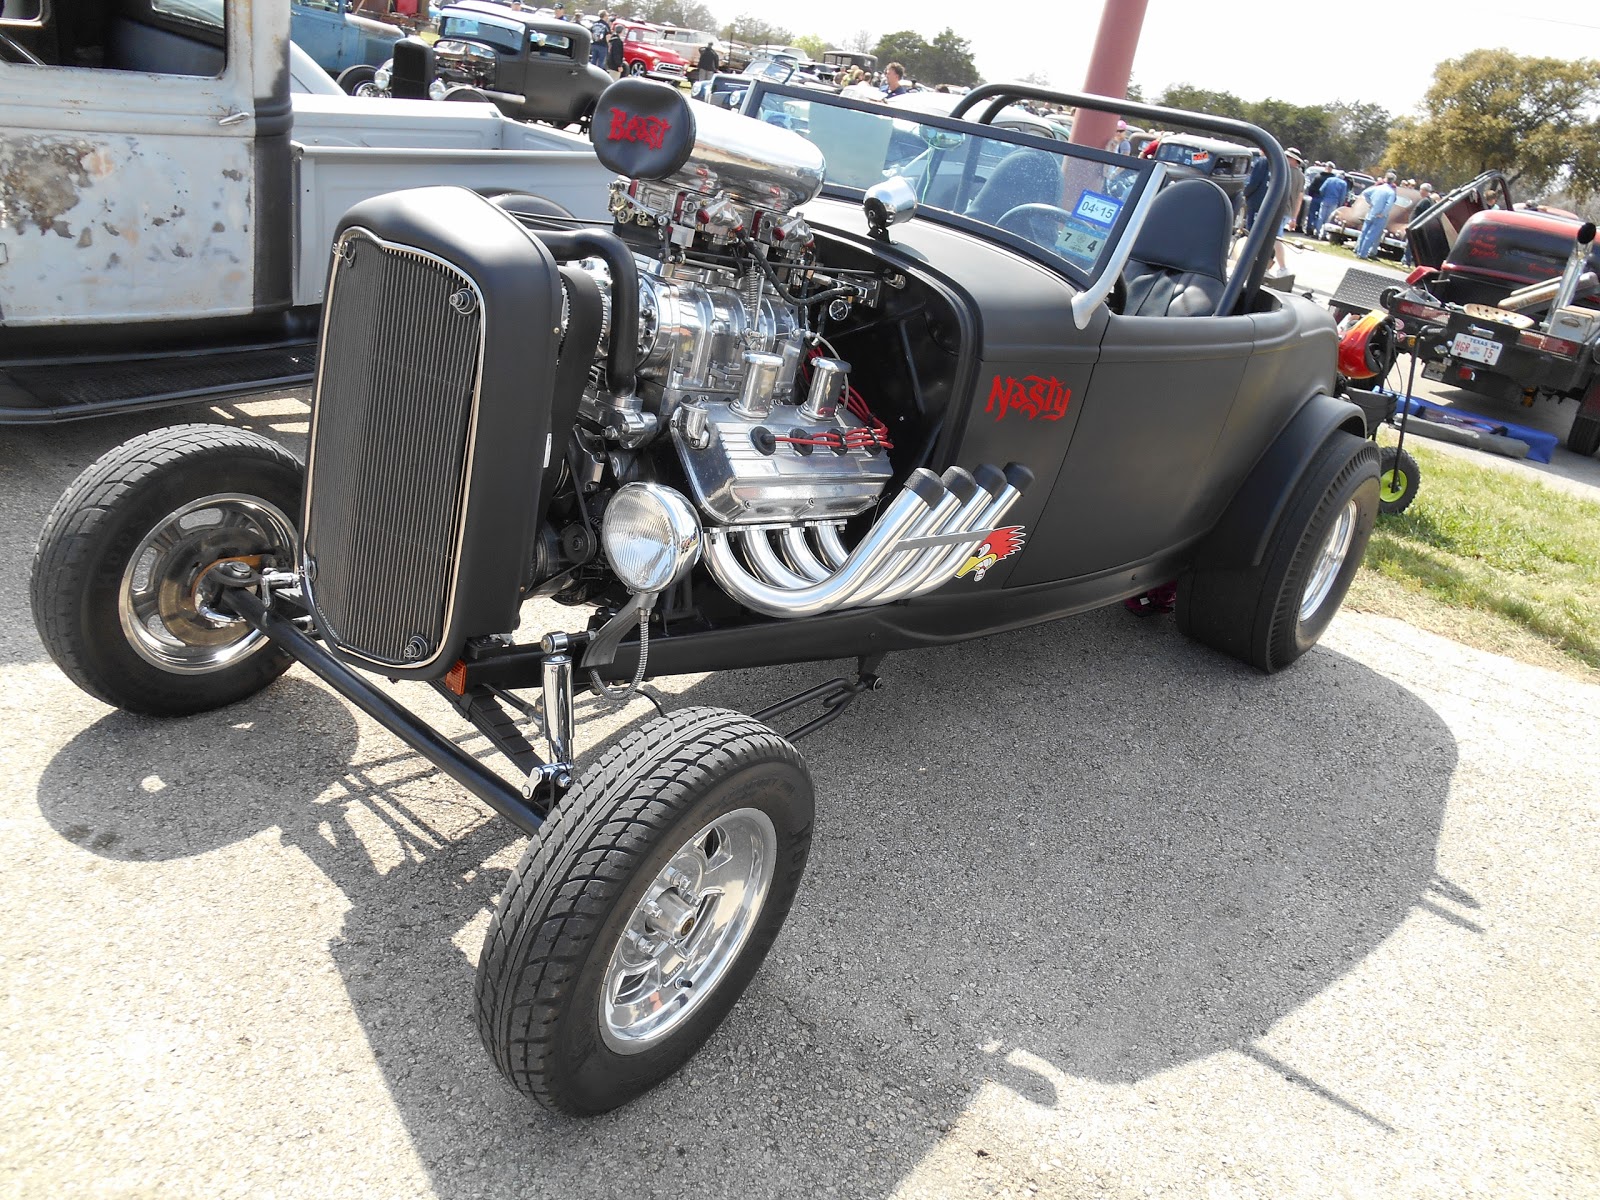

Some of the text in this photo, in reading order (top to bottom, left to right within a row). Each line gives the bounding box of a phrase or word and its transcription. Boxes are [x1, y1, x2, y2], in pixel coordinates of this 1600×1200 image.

[607, 107, 672, 150] Beast
[1064, 232, 1072, 241] 7
[1087, 240, 1098, 252] 4
[1470, 338, 1488, 347] TEXAS
[984, 374, 1072, 422] Nasty
